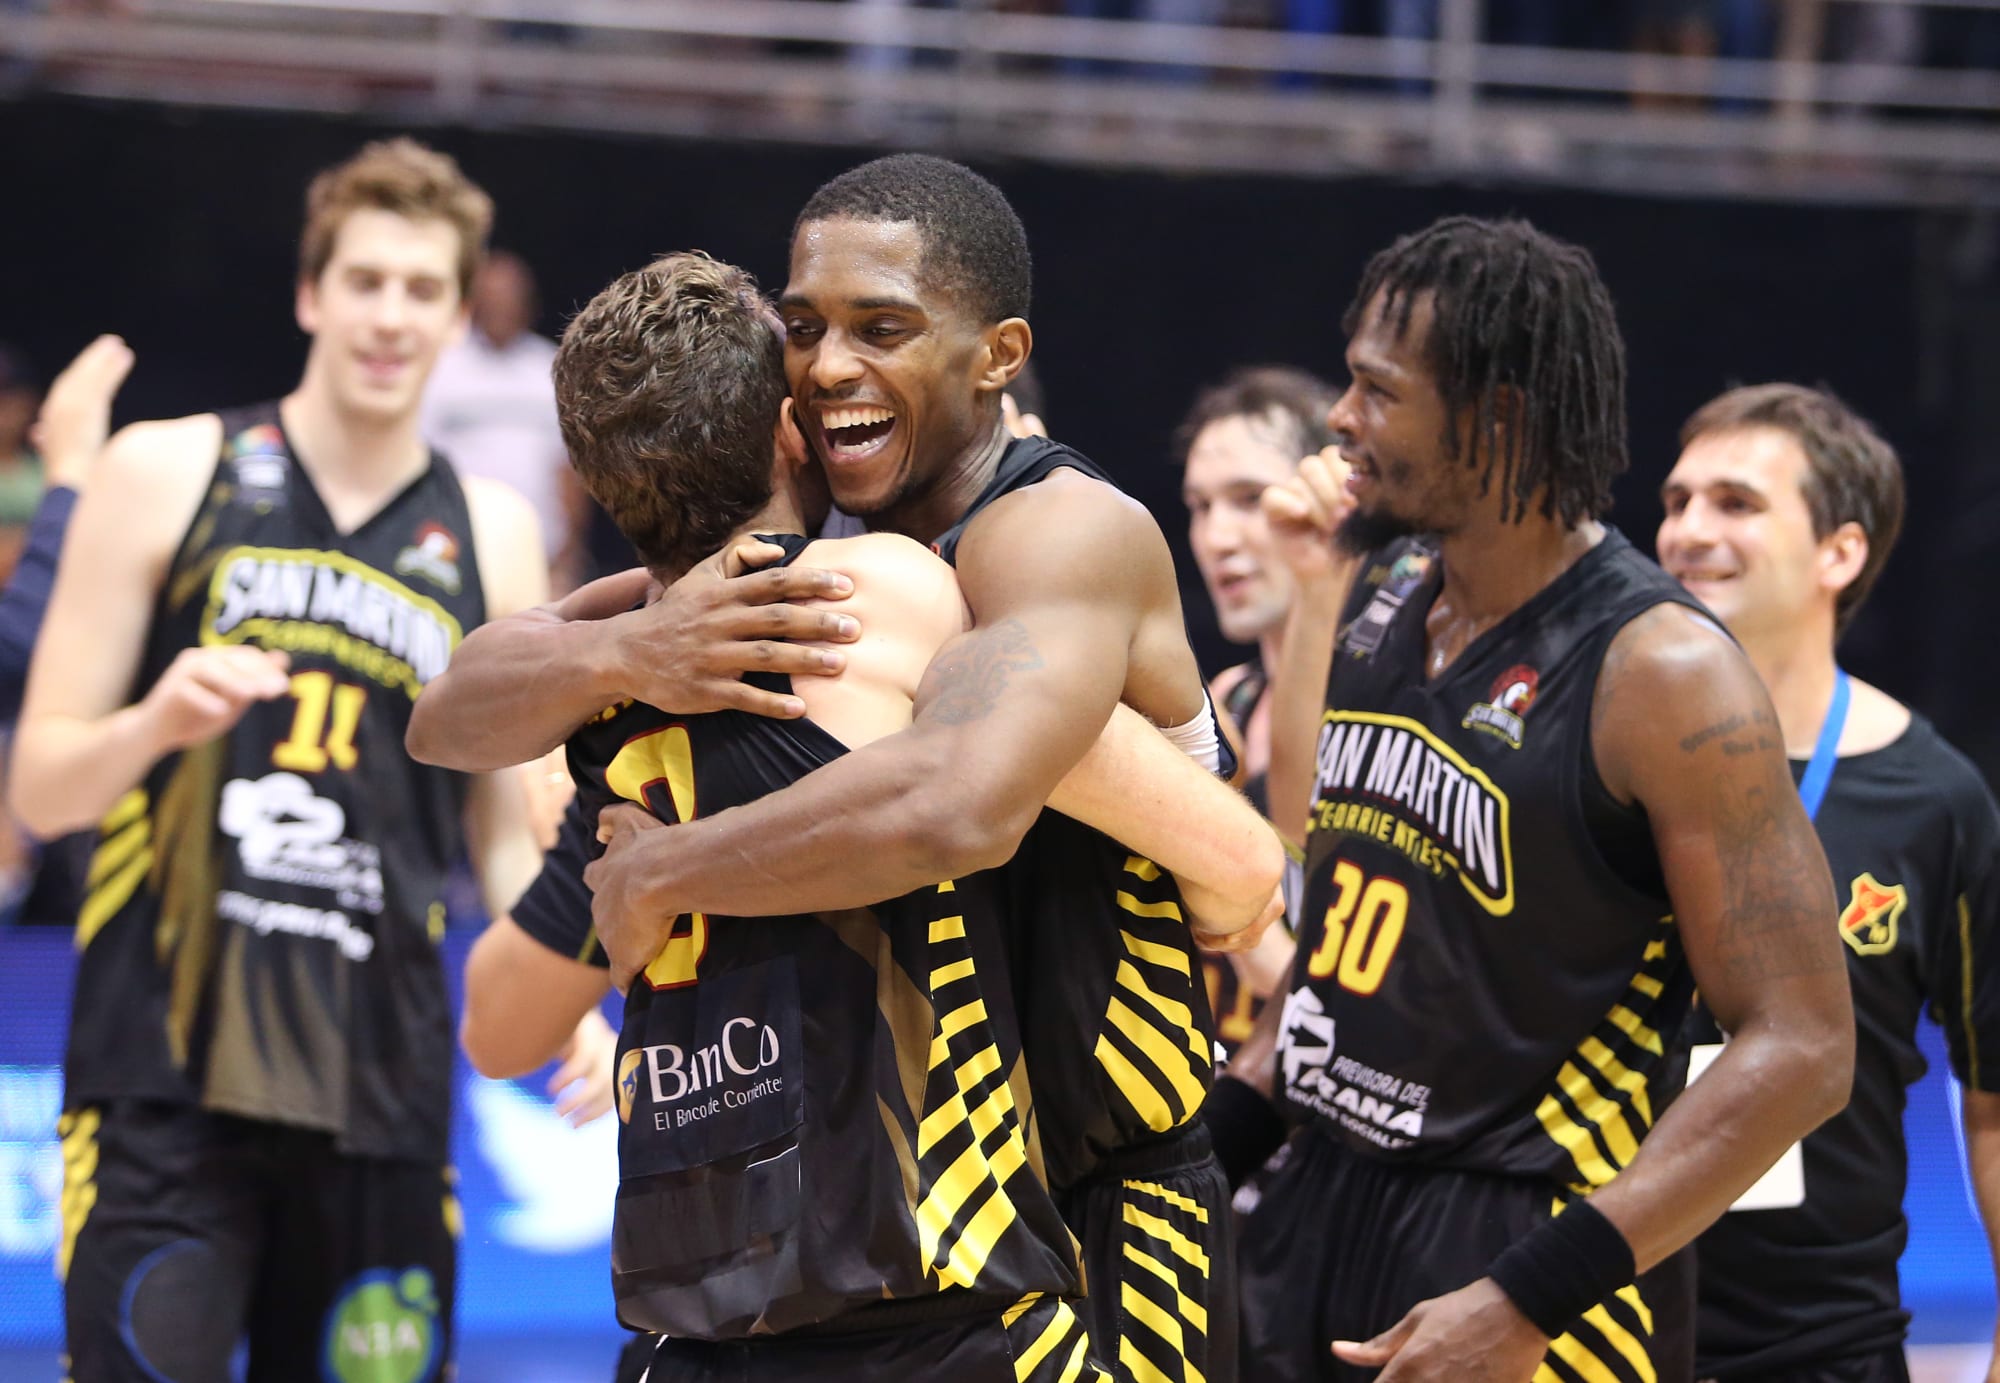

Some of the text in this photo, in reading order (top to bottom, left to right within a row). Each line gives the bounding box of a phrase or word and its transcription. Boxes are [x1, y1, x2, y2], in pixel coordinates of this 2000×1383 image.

[1364, 728, 1498, 890] MARTIN
[1307, 858, 1409, 996] 30
[654, 1112, 671, 1131] El
[1330, 1055, 1432, 1107] PREVISORA DEL
